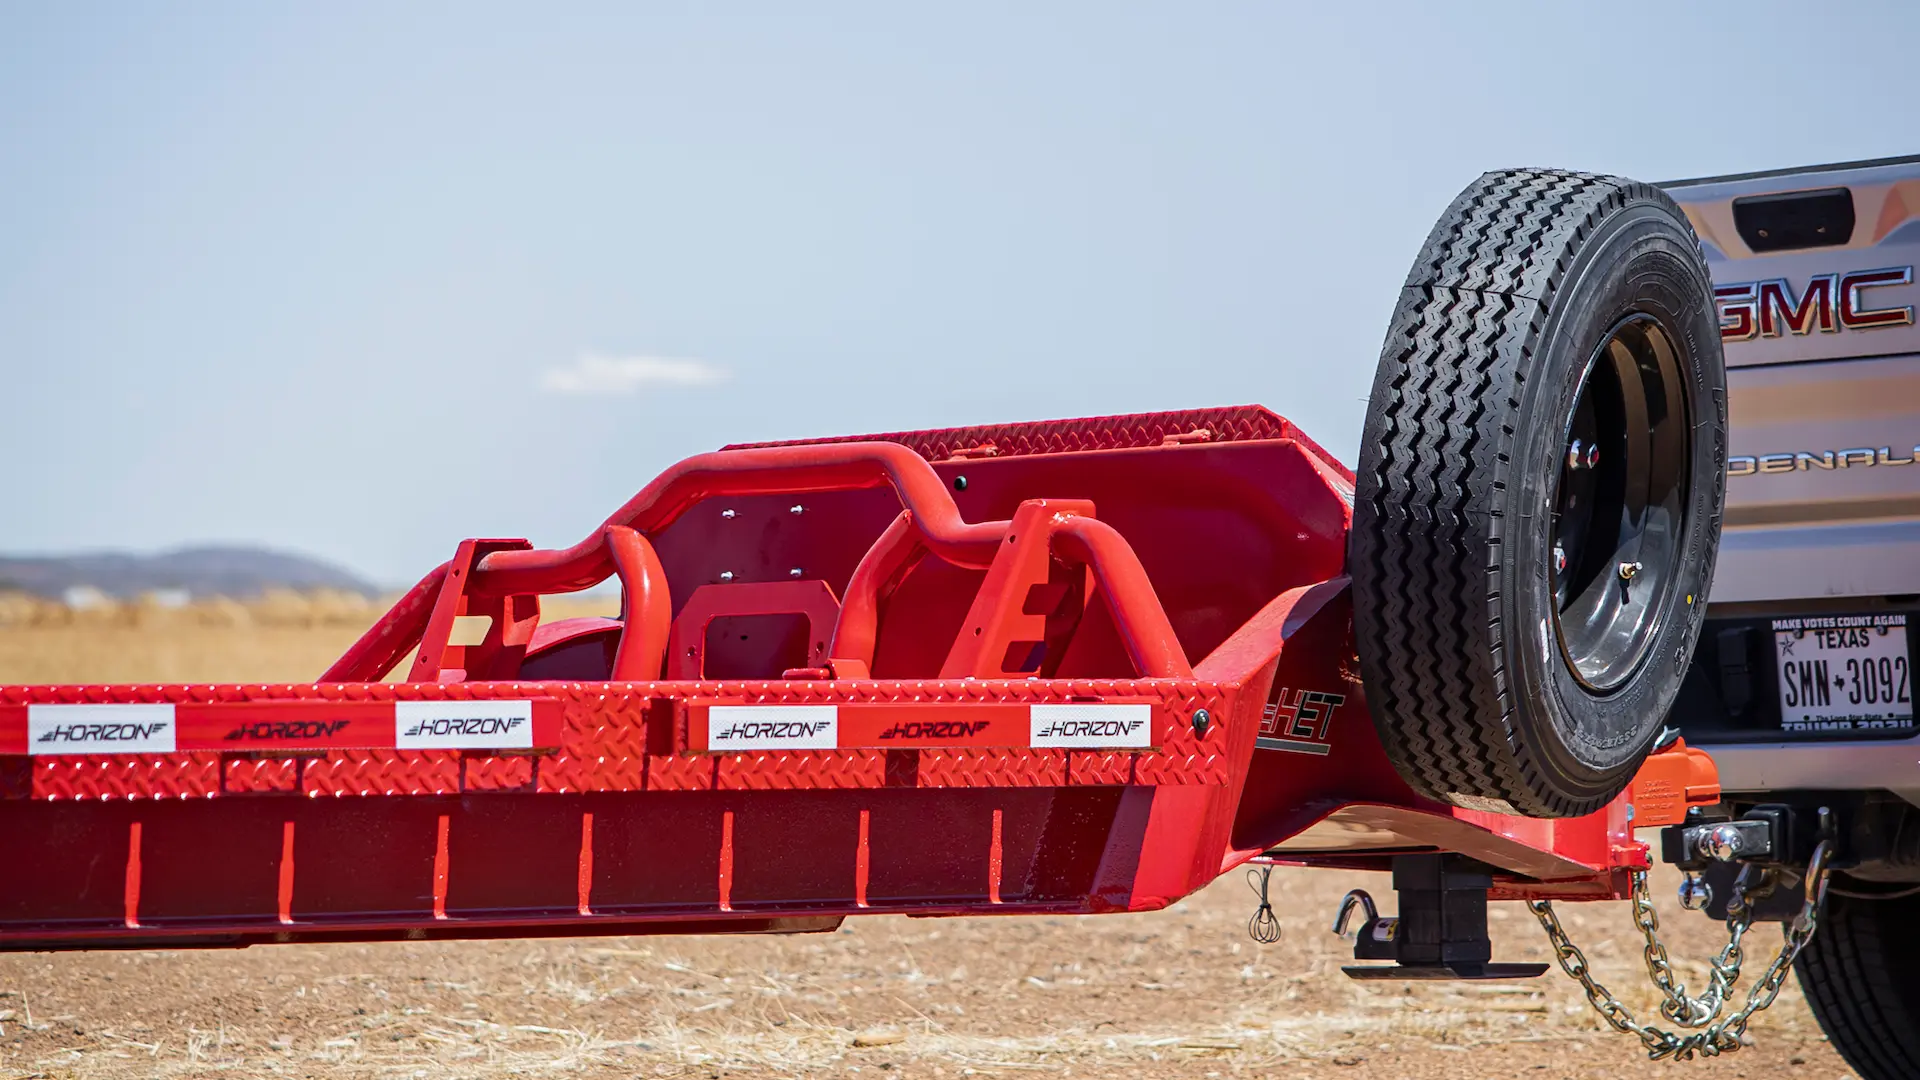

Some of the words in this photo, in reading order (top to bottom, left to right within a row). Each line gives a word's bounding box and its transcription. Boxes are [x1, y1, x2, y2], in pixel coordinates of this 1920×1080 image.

[1714, 265, 1914, 343] GMC
[1772, 619, 1802, 630] MAKE
[1803, 617, 1836, 629] VOTES
[1837, 616, 1872, 627] COUNT
[1873, 615, 1907, 625] AGAIN
[1815, 628, 1870, 650] TEXAS
[1784, 660, 1831, 707] SMN
[1846, 656, 1910, 705] 3092
[50, 723, 155, 742] HORIZON
[238, 720, 338, 740] HORIZON
[418, 717, 513, 736] HORIZON
[729, 721, 818, 739] HORIZON
[891, 720, 978, 739] HORIZON
[1049, 720, 1132, 737] HORIZON
